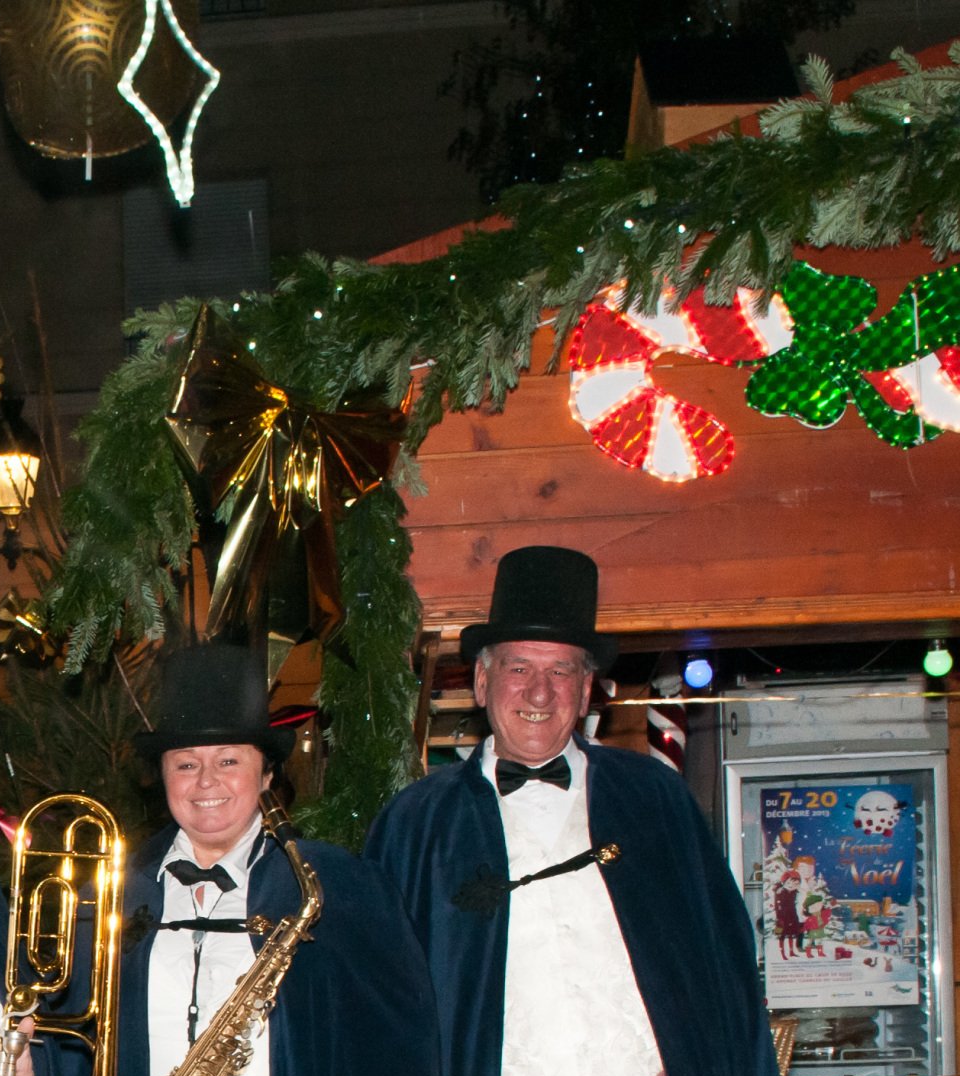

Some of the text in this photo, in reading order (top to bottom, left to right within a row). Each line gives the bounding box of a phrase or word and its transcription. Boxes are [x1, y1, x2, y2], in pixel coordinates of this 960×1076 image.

[779, 791, 792, 810] 7
[806, 791, 838, 809] 20
[766, 808, 810, 818] DÉCEMBRE
[844, 859, 904, 885] Noël
